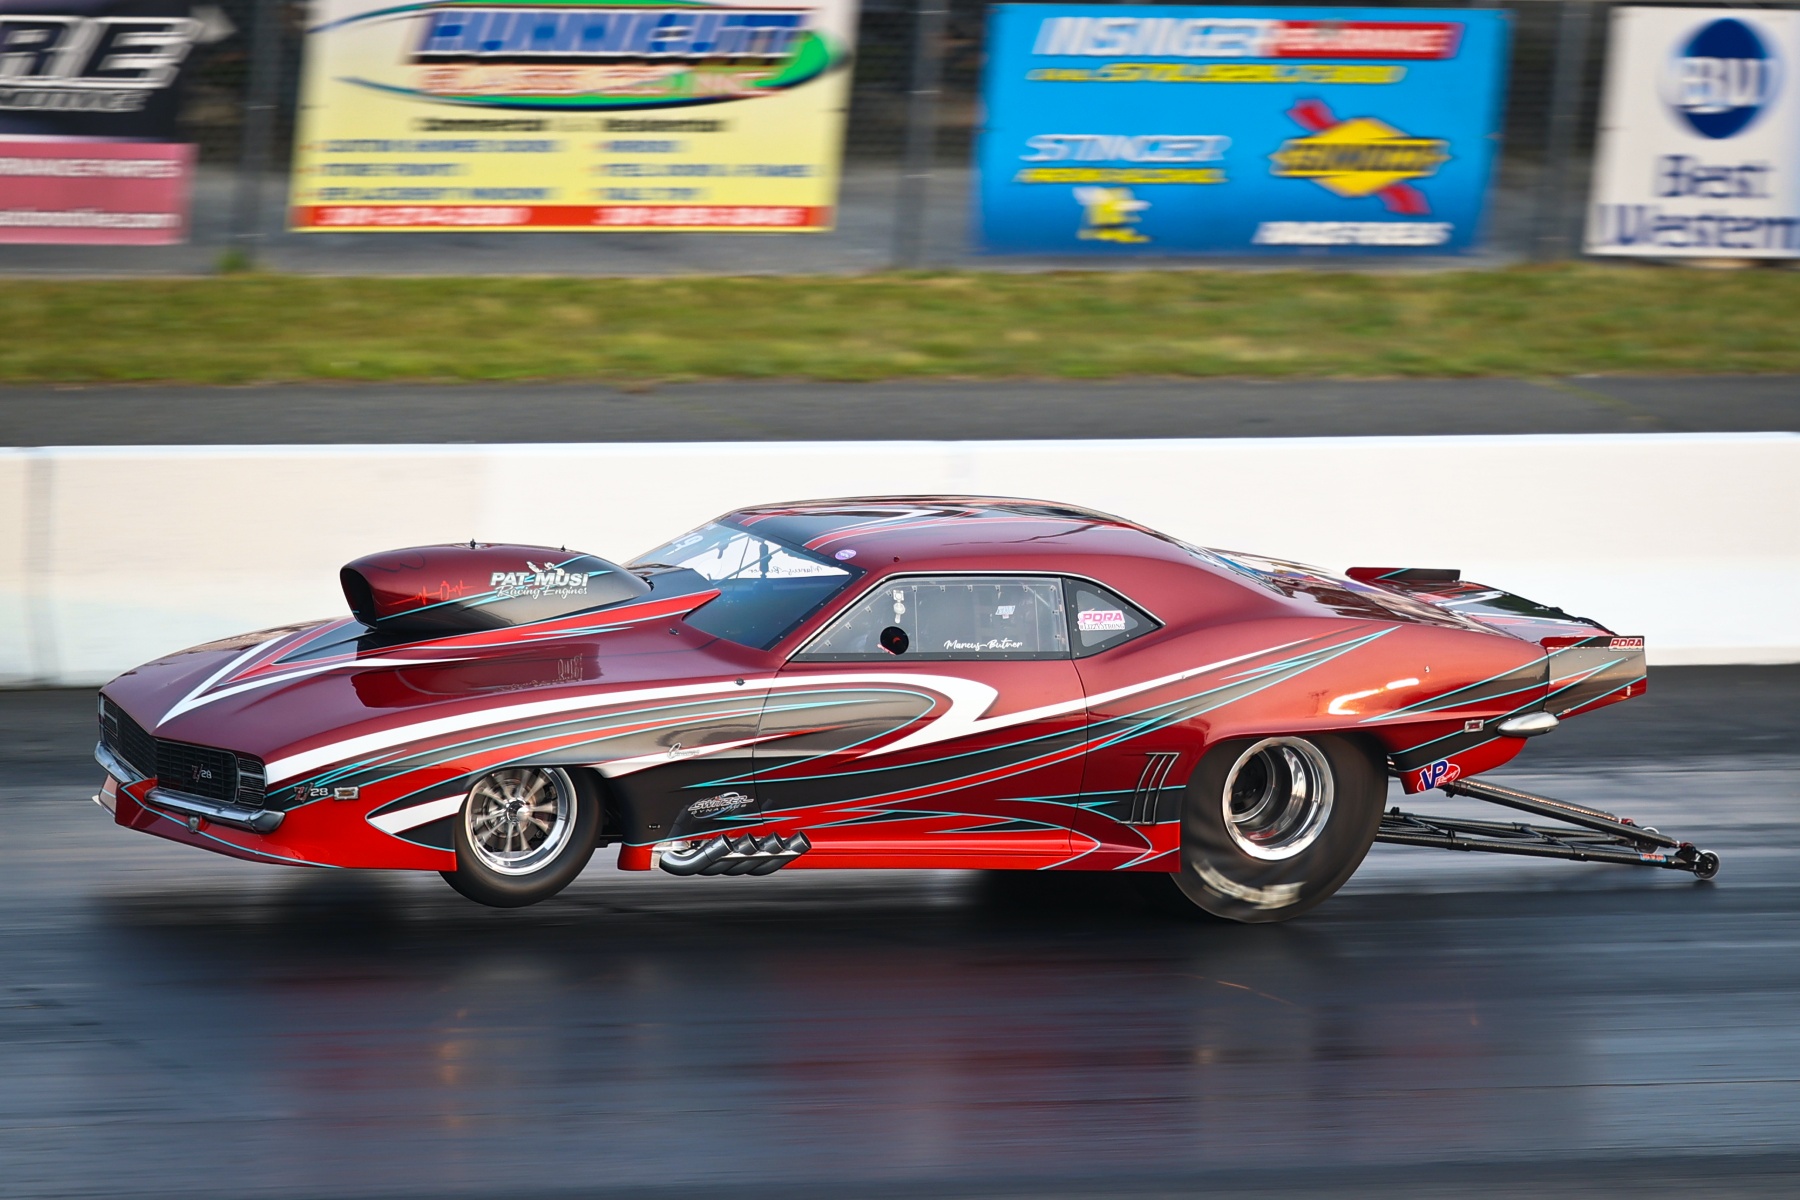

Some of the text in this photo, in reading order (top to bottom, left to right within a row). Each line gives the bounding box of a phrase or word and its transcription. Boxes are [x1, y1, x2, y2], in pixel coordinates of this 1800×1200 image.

[1656, 154, 1772, 199] Best
[1602, 204, 1800, 249] Western
[489, 572, 589, 587] PAT MUSI
[495, 585, 588, 599] Racing Engines
[1419, 760, 1449, 790] VP
